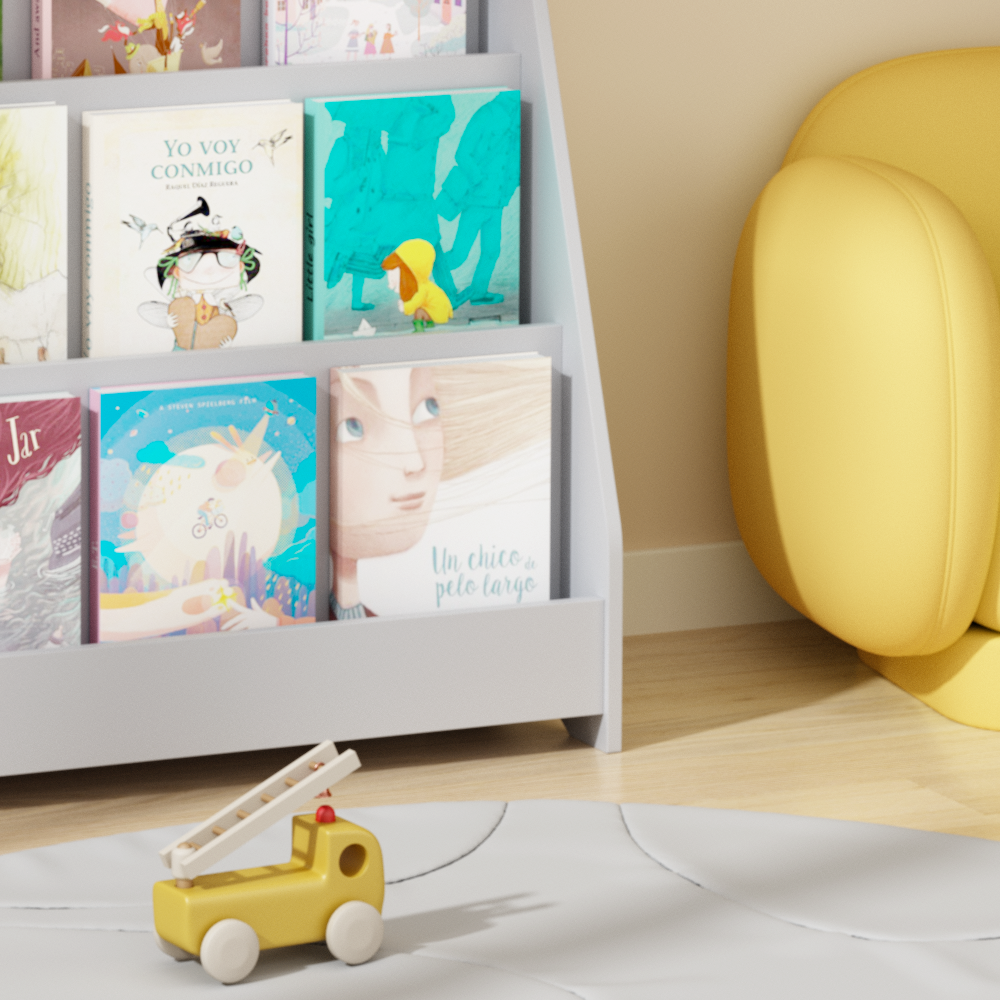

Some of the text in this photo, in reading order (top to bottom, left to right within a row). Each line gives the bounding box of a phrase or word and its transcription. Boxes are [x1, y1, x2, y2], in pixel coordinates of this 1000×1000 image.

[199, 138, 242, 156] VOY
[151, 159, 254, 180] CONMIGO
[305, 210, 316, 247] girl
[6, 415, 42, 466] Jar
[432, 544, 538, 574] Un chico de
[435, 573, 538, 608] pelo largo
